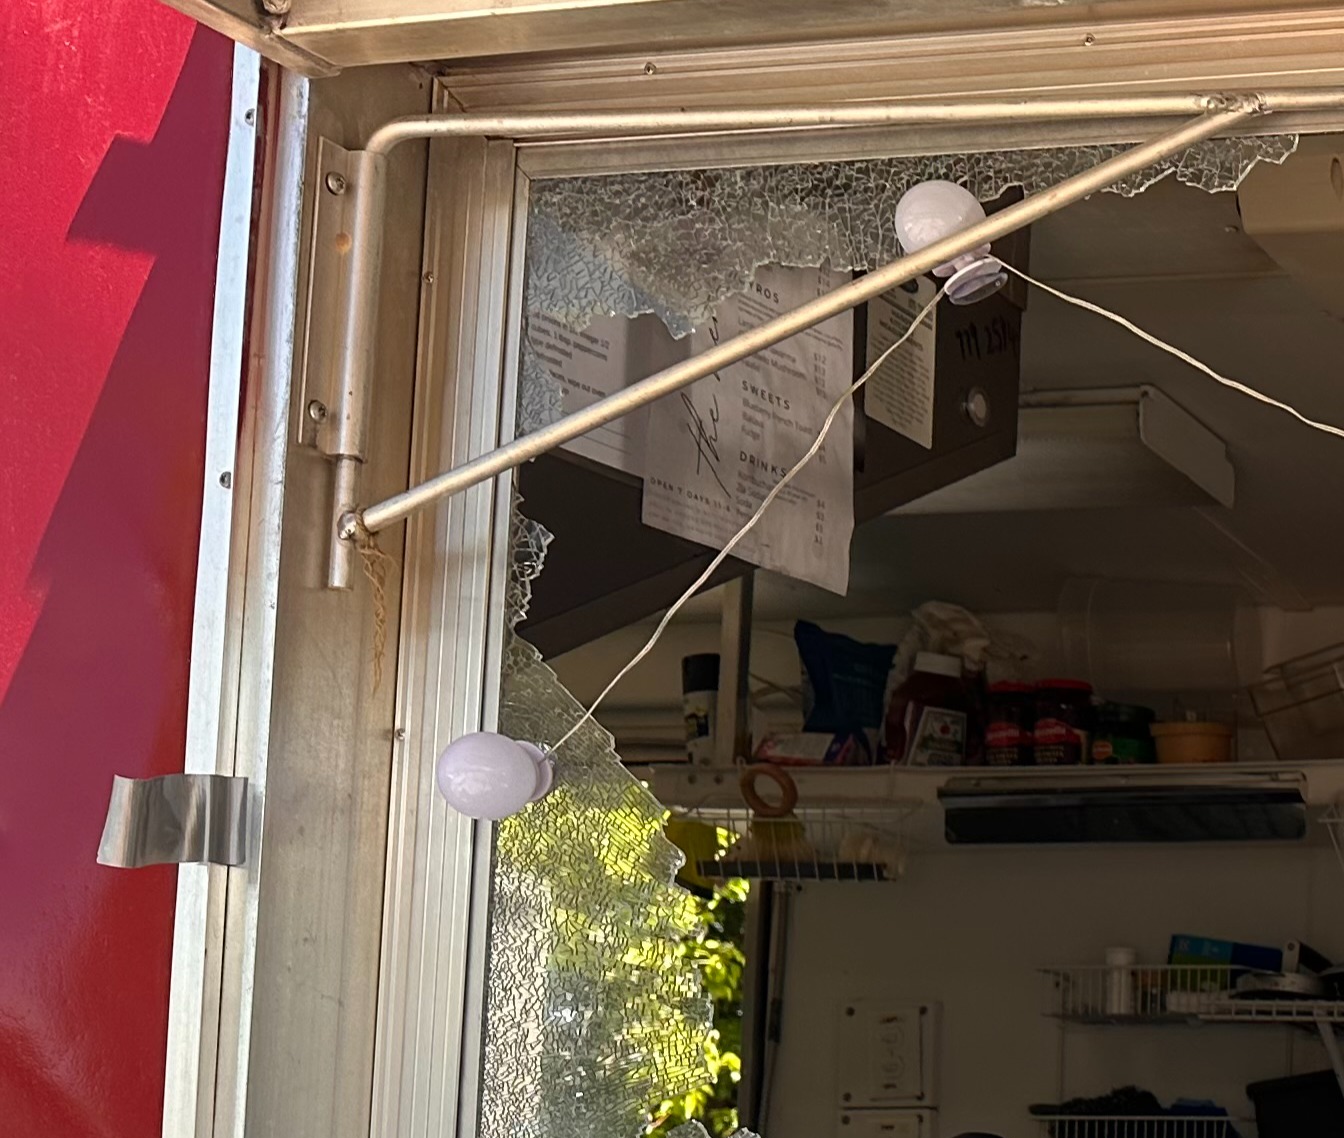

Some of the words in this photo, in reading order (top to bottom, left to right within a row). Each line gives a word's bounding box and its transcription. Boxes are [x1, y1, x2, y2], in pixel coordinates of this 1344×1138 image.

[748, 281, 780, 303] YROS
[741, 379, 791, 411] SWEETS
[740, 450, 788, 479] DRINKS
